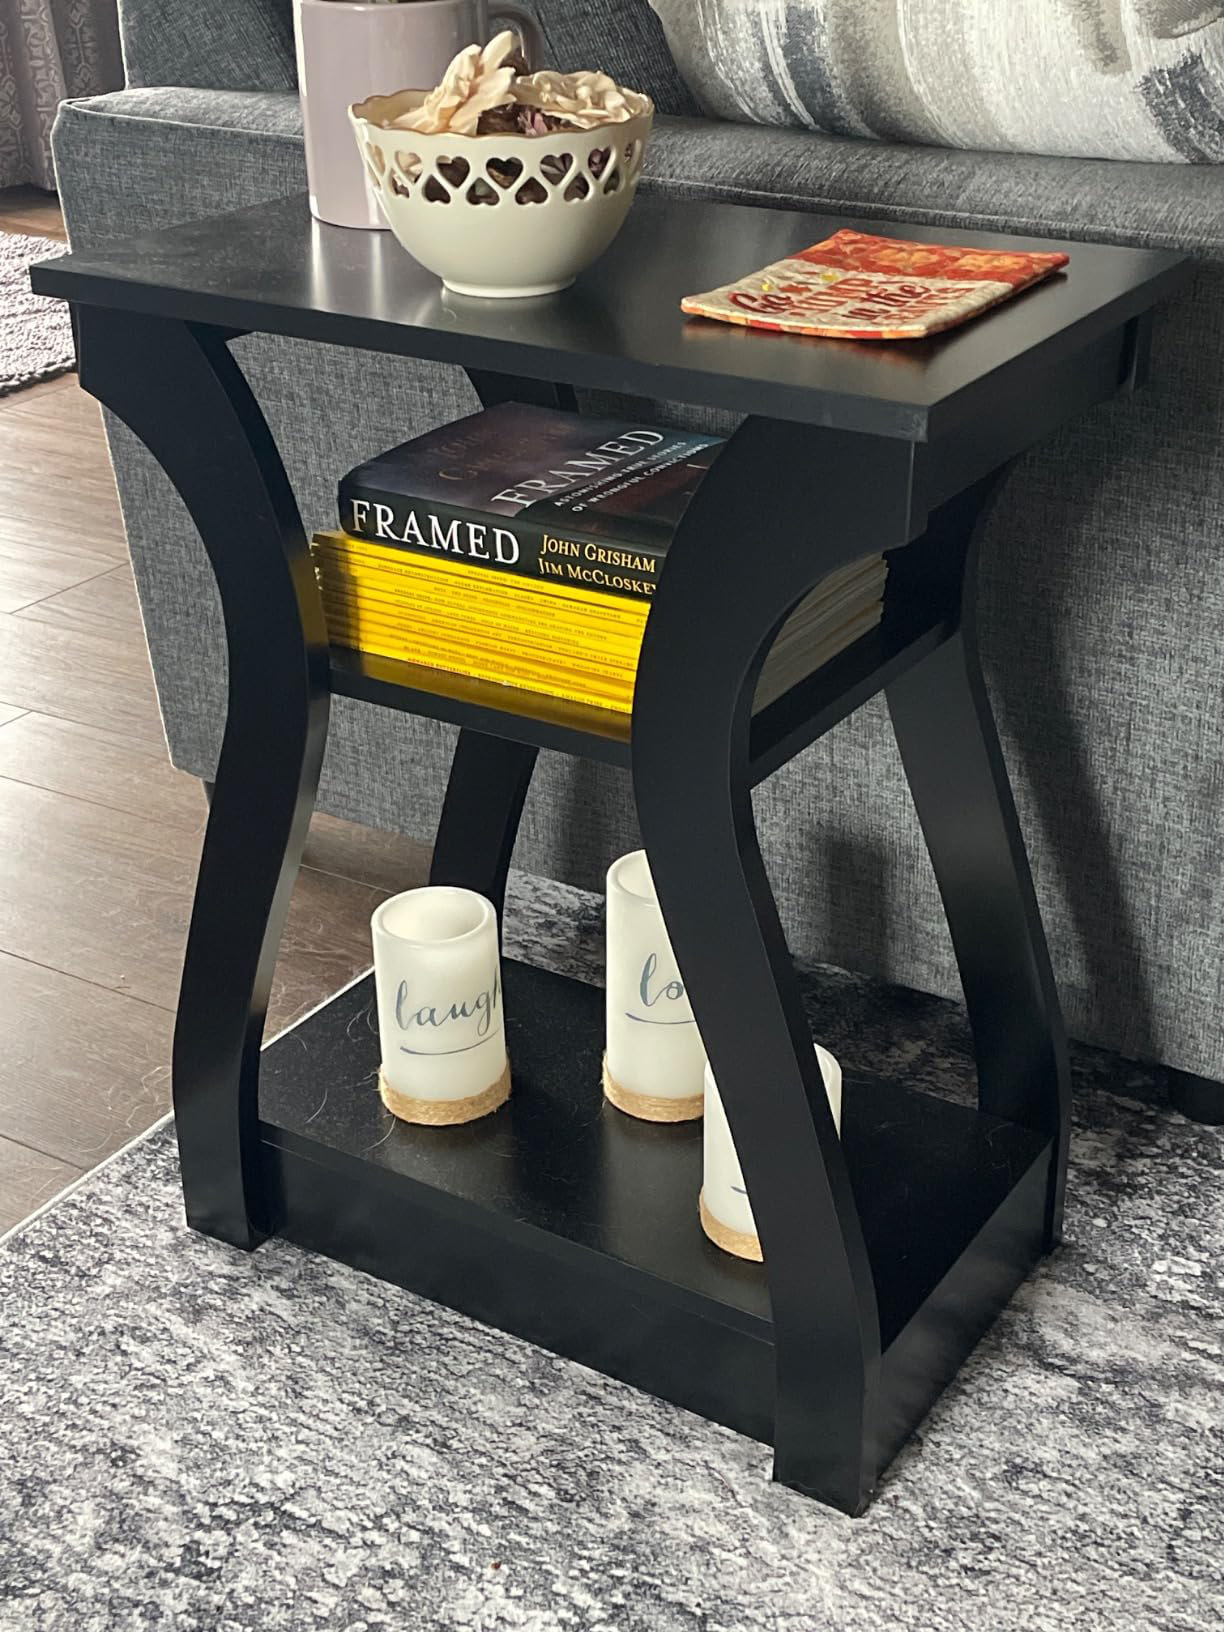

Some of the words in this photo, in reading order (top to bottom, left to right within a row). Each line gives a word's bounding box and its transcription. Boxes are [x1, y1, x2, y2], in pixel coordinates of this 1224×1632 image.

[490, 430, 665, 508] FRAMED
[570, 502, 588, 512] OF
[351, 500, 520, 565] FRAMED
[538, 558, 564, 576] JIM
[540, 534, 581, 557] JOHN
[584, 543, 656, 573] GRISHAM
